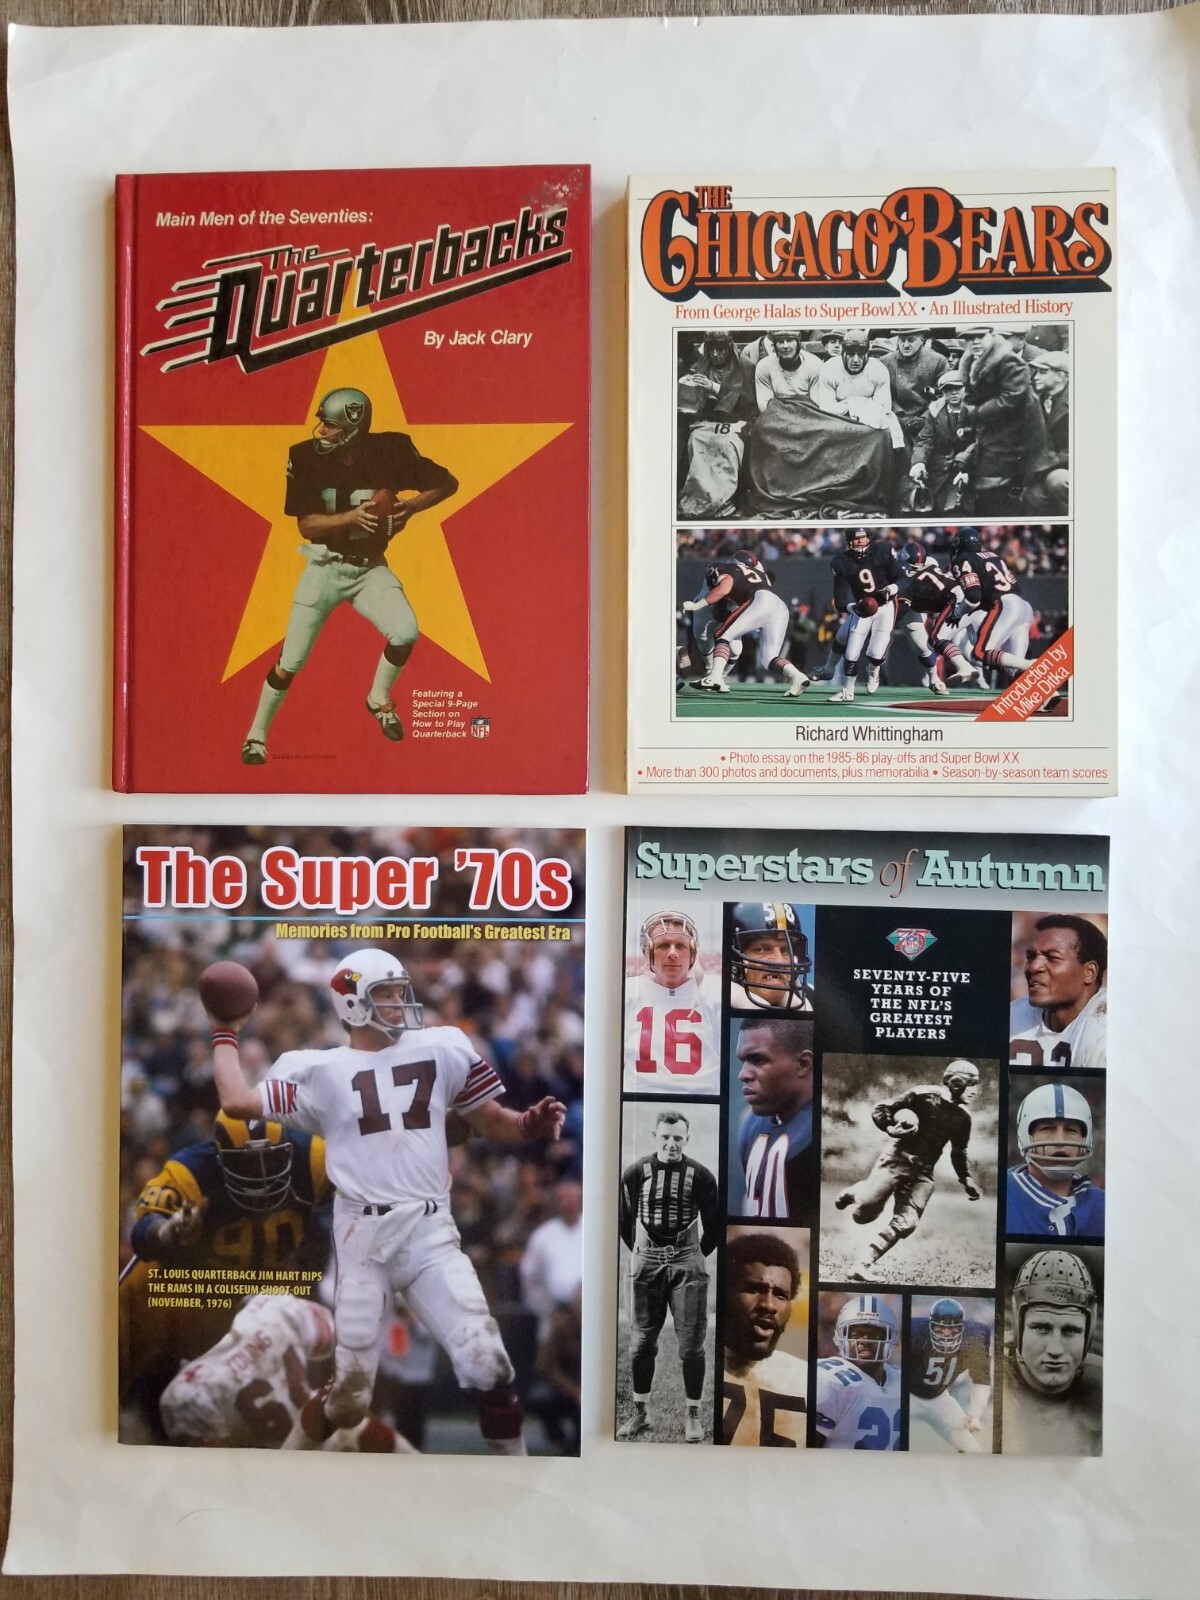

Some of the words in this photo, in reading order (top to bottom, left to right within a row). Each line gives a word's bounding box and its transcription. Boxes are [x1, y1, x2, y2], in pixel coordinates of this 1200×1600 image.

[693, 185, 733, 211] THE
[155, 211, 195, 227] Main
[198, 210, 235, 227] Men
[238, 209, 257, 226] of
[258, 209, 286, 225] the
[288, 208, 374, 225] Seventies:
[640, 190, 900, 302] CHICAGO
[882, 186, 1113, 298] BEARS
[140, 206, 572, 374] Quarterbacks
[674, 304, 710, 320] From
[713, 303, 760, 322] George
[763, 303, 802, 318] Halas
[804, 303, 818, 318] to
[819, 302, 858, 320] Super
[860, 302, 896, 317] Bowl
[897, 302, 918, 317] XX
[929, 301, 949, 316] An
[952, 300, 1022, 316] Illustrated
[1024, 299, 1074, 318] History
[423, 330, 446, 347] By
[448, 330, 486, 346] Jack
[490, 329, 532, 348] Clary
[714, 423, 731, 435] 18
[859, 568, 876, 593] 9
[992, 658, 1054, 716] Introduction
[1047, 644, 1067, 663] by
[412, 689, 455, 699] Featuring
[457, 690, 463, 698] a
[1013, 691, 1043, 718] Mike
[1037, 666, 1070, 695] Ditka
[412, 699, 445, 709] Special
[447, 699, 479, 709] 9-Page
[412, 709, 446, 718] Section
[448, 710, 460, 718] on
[412, 719, 433, 728] How
[435, 720, 444, 728] to
[446, 719, 466, 730] Play
[412, 729, 467, 738] Quarterback
[795, 726, 850, 742] Richard
[852, 726, 944, 745] Whittingham
[729, 752, 759, 764] Photo
[761, 753, 791, 767] essay
[793, 754, 807, 764] on
[808, 752, 825, 764] the
[826, 752, 869, 764] 1985-86
[871, 751, 917, 766] play-offs
[918, 751, 938, 764] and
[940, 751, 972, 766] Super
[974, 751, 1000, 764] Bowl
[1002, 751, 1020, 764] XX
[646, 766, 673, 778] More
[674, 766, 697, 778] than
[699, 766, 720, 778] 300
[722, 766, 757, 781] photos
[758, 766, 778, 778] and
[780, 766, 841, 780] documents,
[842, 766, 863, 781] plus
[865, 766, 930, 778] memorabilia
[942, 766, 1041, 780] Season-by-season
[1042, 767, 1070, 779] team
[1072, 768, 1108, 779] scores
[635, 841, 875, 891] Superstars
[879, 848, 919, 898] of
[916, 848, 1106, 893] Autumn
[136, 846, 247, 908] The
[261, 846, 439, 915] Super
[275, 922, 348, 939] Memories
[350, 922, 384, 939] from
[386, 923, 411, 939] Pro
[413, 923, 483, 940] Football's
[484, 924, 546, 940] Greatest
[548, 924, 571, 940] Era
[853, 969, 970, 983] SEVENTY-FIVE
[871, 984, 924, 996] YEARS
[929, 986, 952, 997] OF
[870, 998, 902, 1010] THE
[907, 999, 952, 1011] NFL'S
[869, 1012, 953, 1026] GREATEST
[634, 1006, 703, 1075] 16
[875, 1026, 946, 1040] PLAYERS
[351, 1059, 437, 1137] 17
[147, 1268, 162, 1279] ST.
[163, 1268, 190, 1280] LOUIS
[191, 1269, 256, 1281] QUARTERBACK
[257, 1270, 274, 1281] JIM
[275, 1270, 300, 1281] HART
[301, 1271, 323, 1282] RIPS
[148, 1283, 166, 1293] THE
[167, 1283, 193, 1294] RAMS
[194, 1284, 205, 1294] IN
[206, 1284, 213, 1294] A
[214, 1284, 259, 1295] COLISEUM
[260, 1285, 312, 1296] SHOOT-OUT
[147, 1297, 205, 1309] (NOVEMBER,
[206, 1298, 232, 1310] 1976)
[923, 1356, 958, 1386] 51
